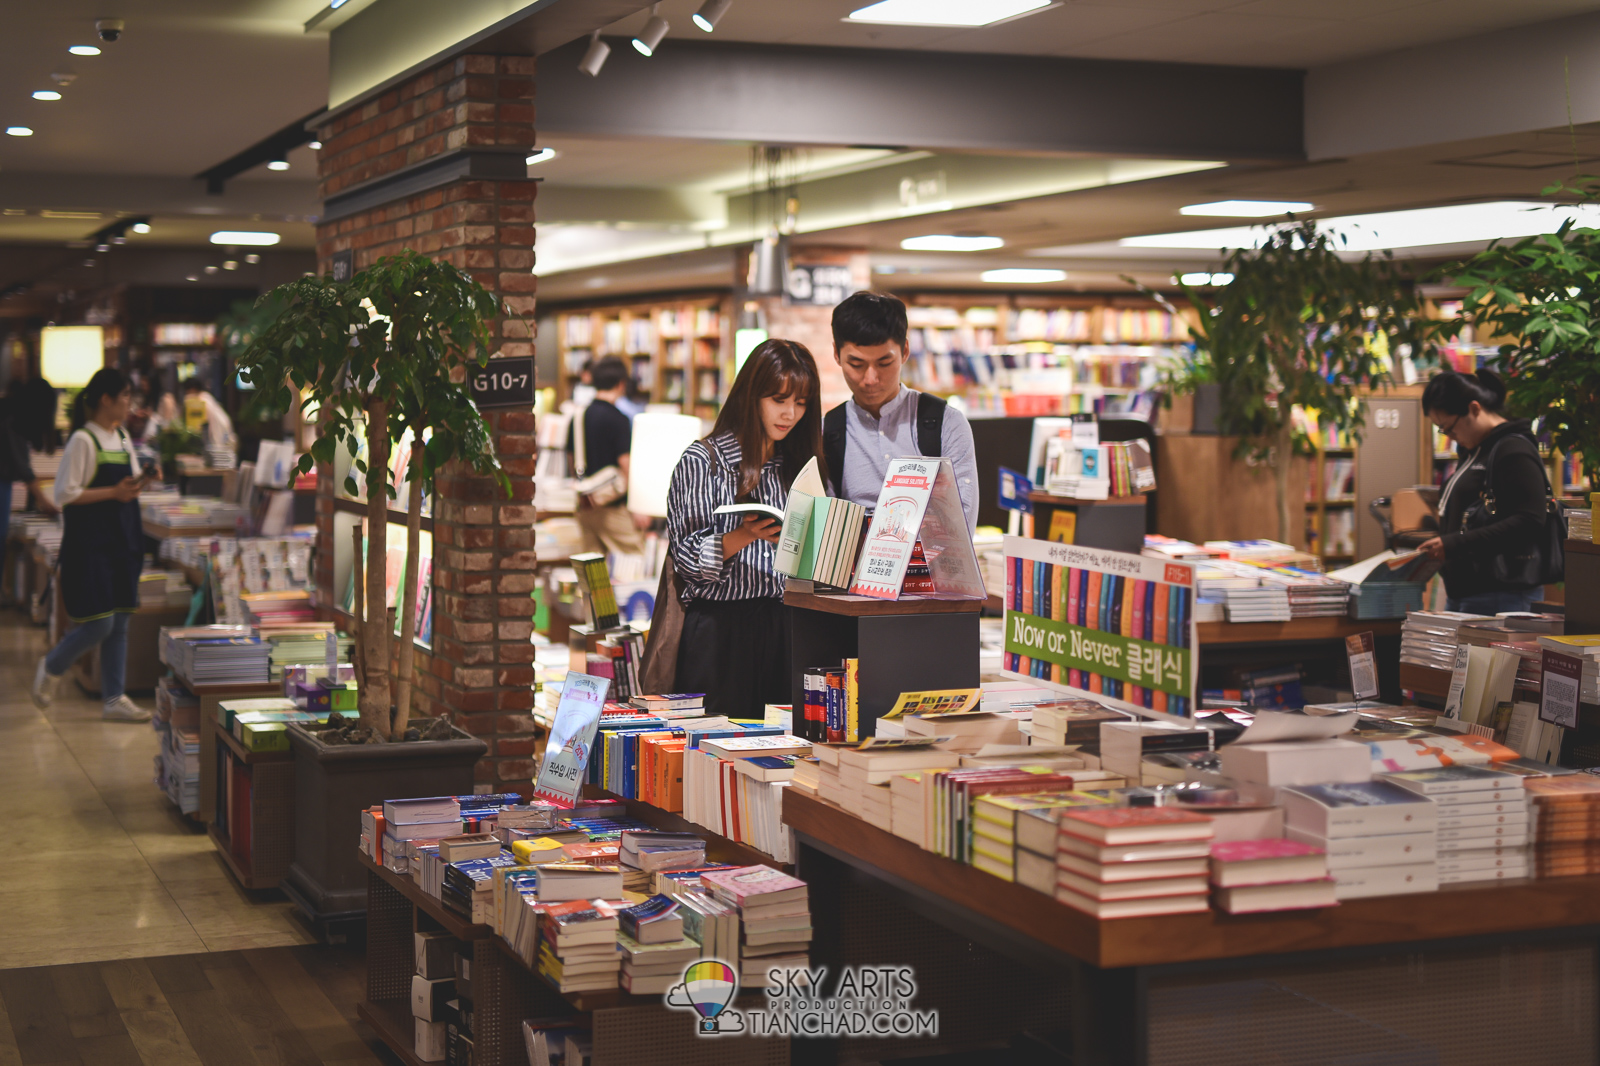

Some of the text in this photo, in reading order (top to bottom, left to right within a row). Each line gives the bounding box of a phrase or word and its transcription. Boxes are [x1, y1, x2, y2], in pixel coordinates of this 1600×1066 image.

[473, 372, 528, 392] G10-7
[1013, 616, 1183, 691] Now or Never 클래식
[549, 761, 578, 781] 직수입 사전
